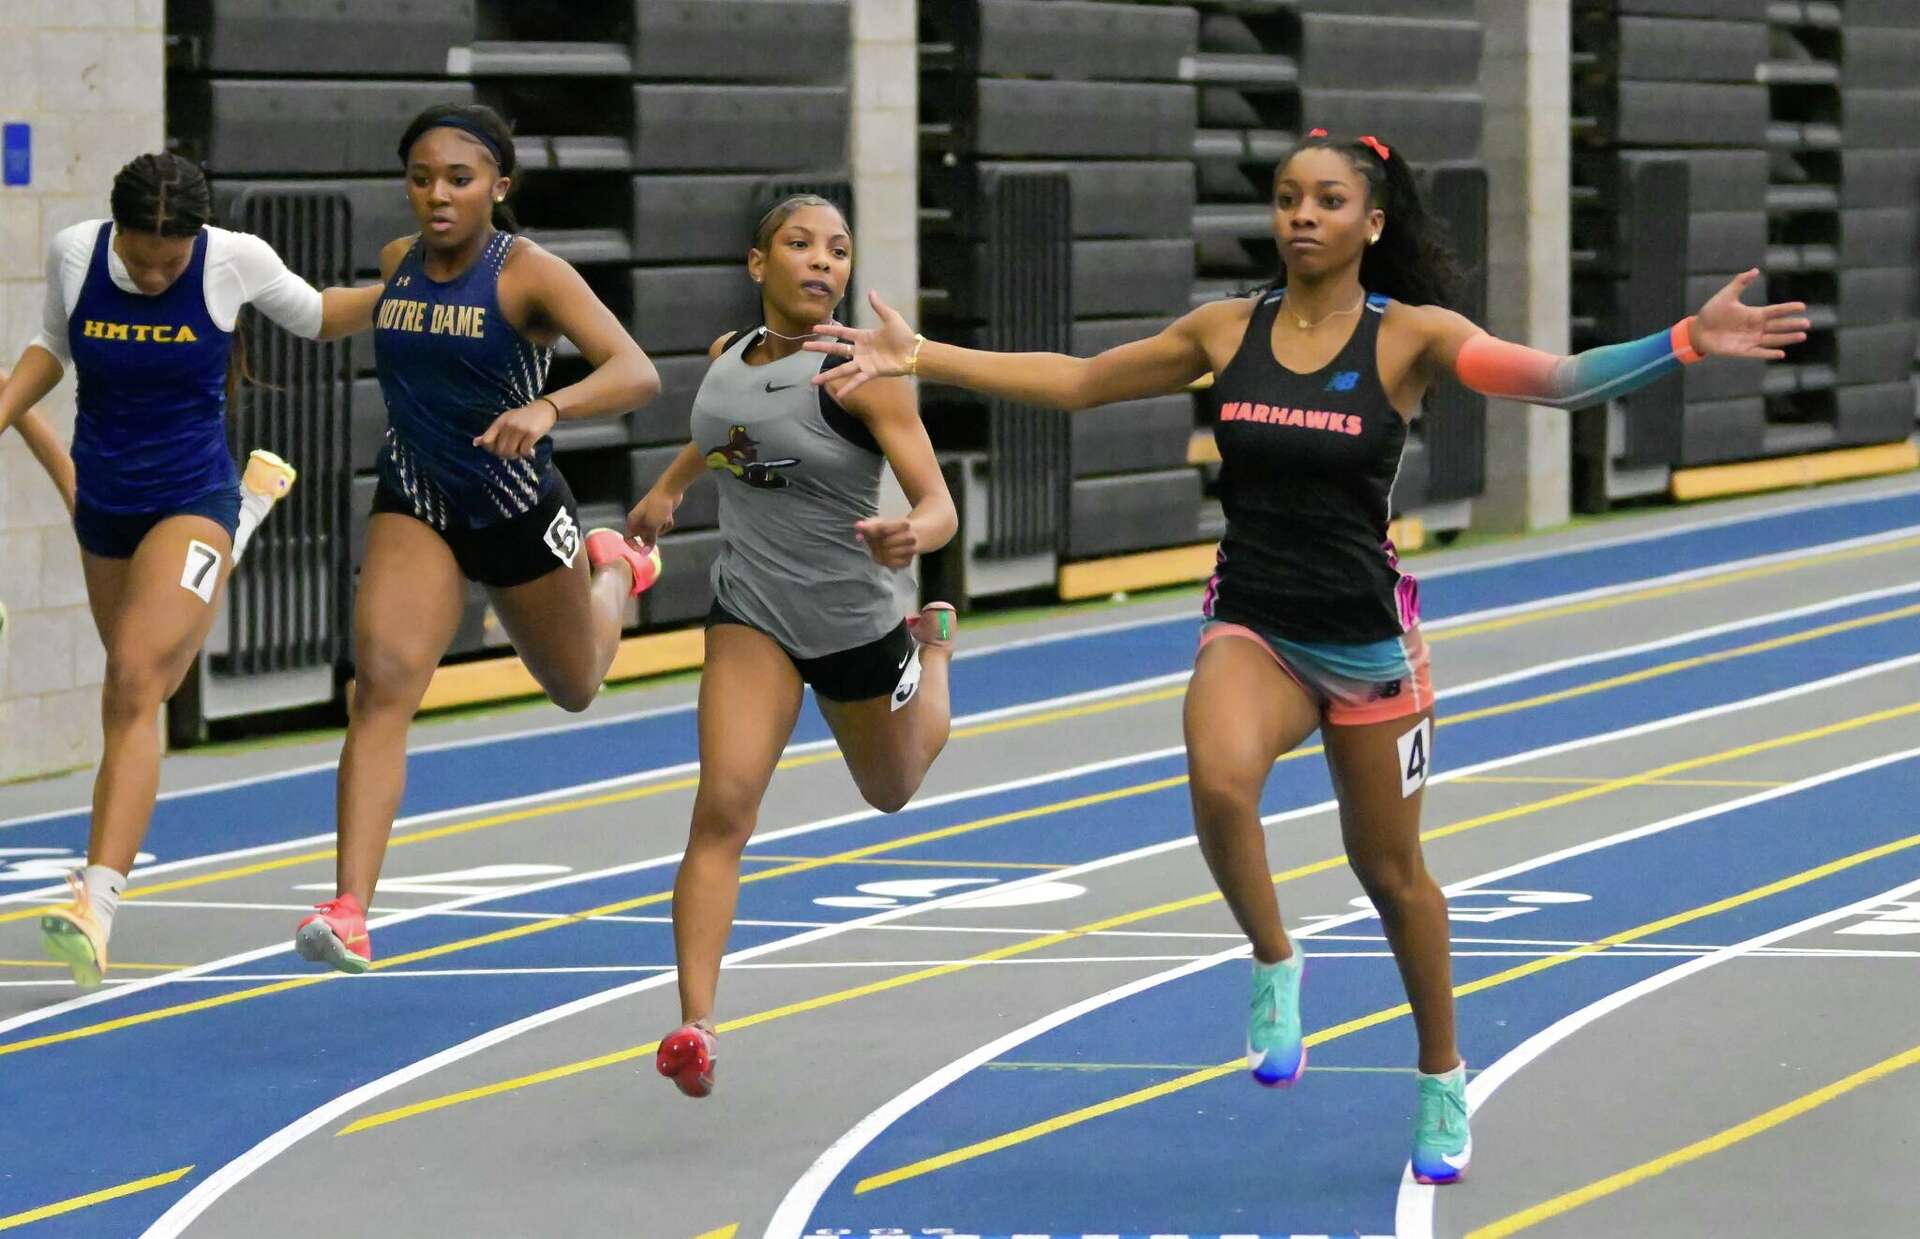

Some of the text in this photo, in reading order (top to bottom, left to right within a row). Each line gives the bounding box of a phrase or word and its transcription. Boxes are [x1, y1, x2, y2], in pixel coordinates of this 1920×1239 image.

[83, 319, 198, 342] HMTCA
[377, 299, 486, 339] NOTRE DAME
[1220, 402, 1363, 436] WARHAWKS
[193, 545, 217, 589] 7
[1406, 728, 1426, 780] 4
